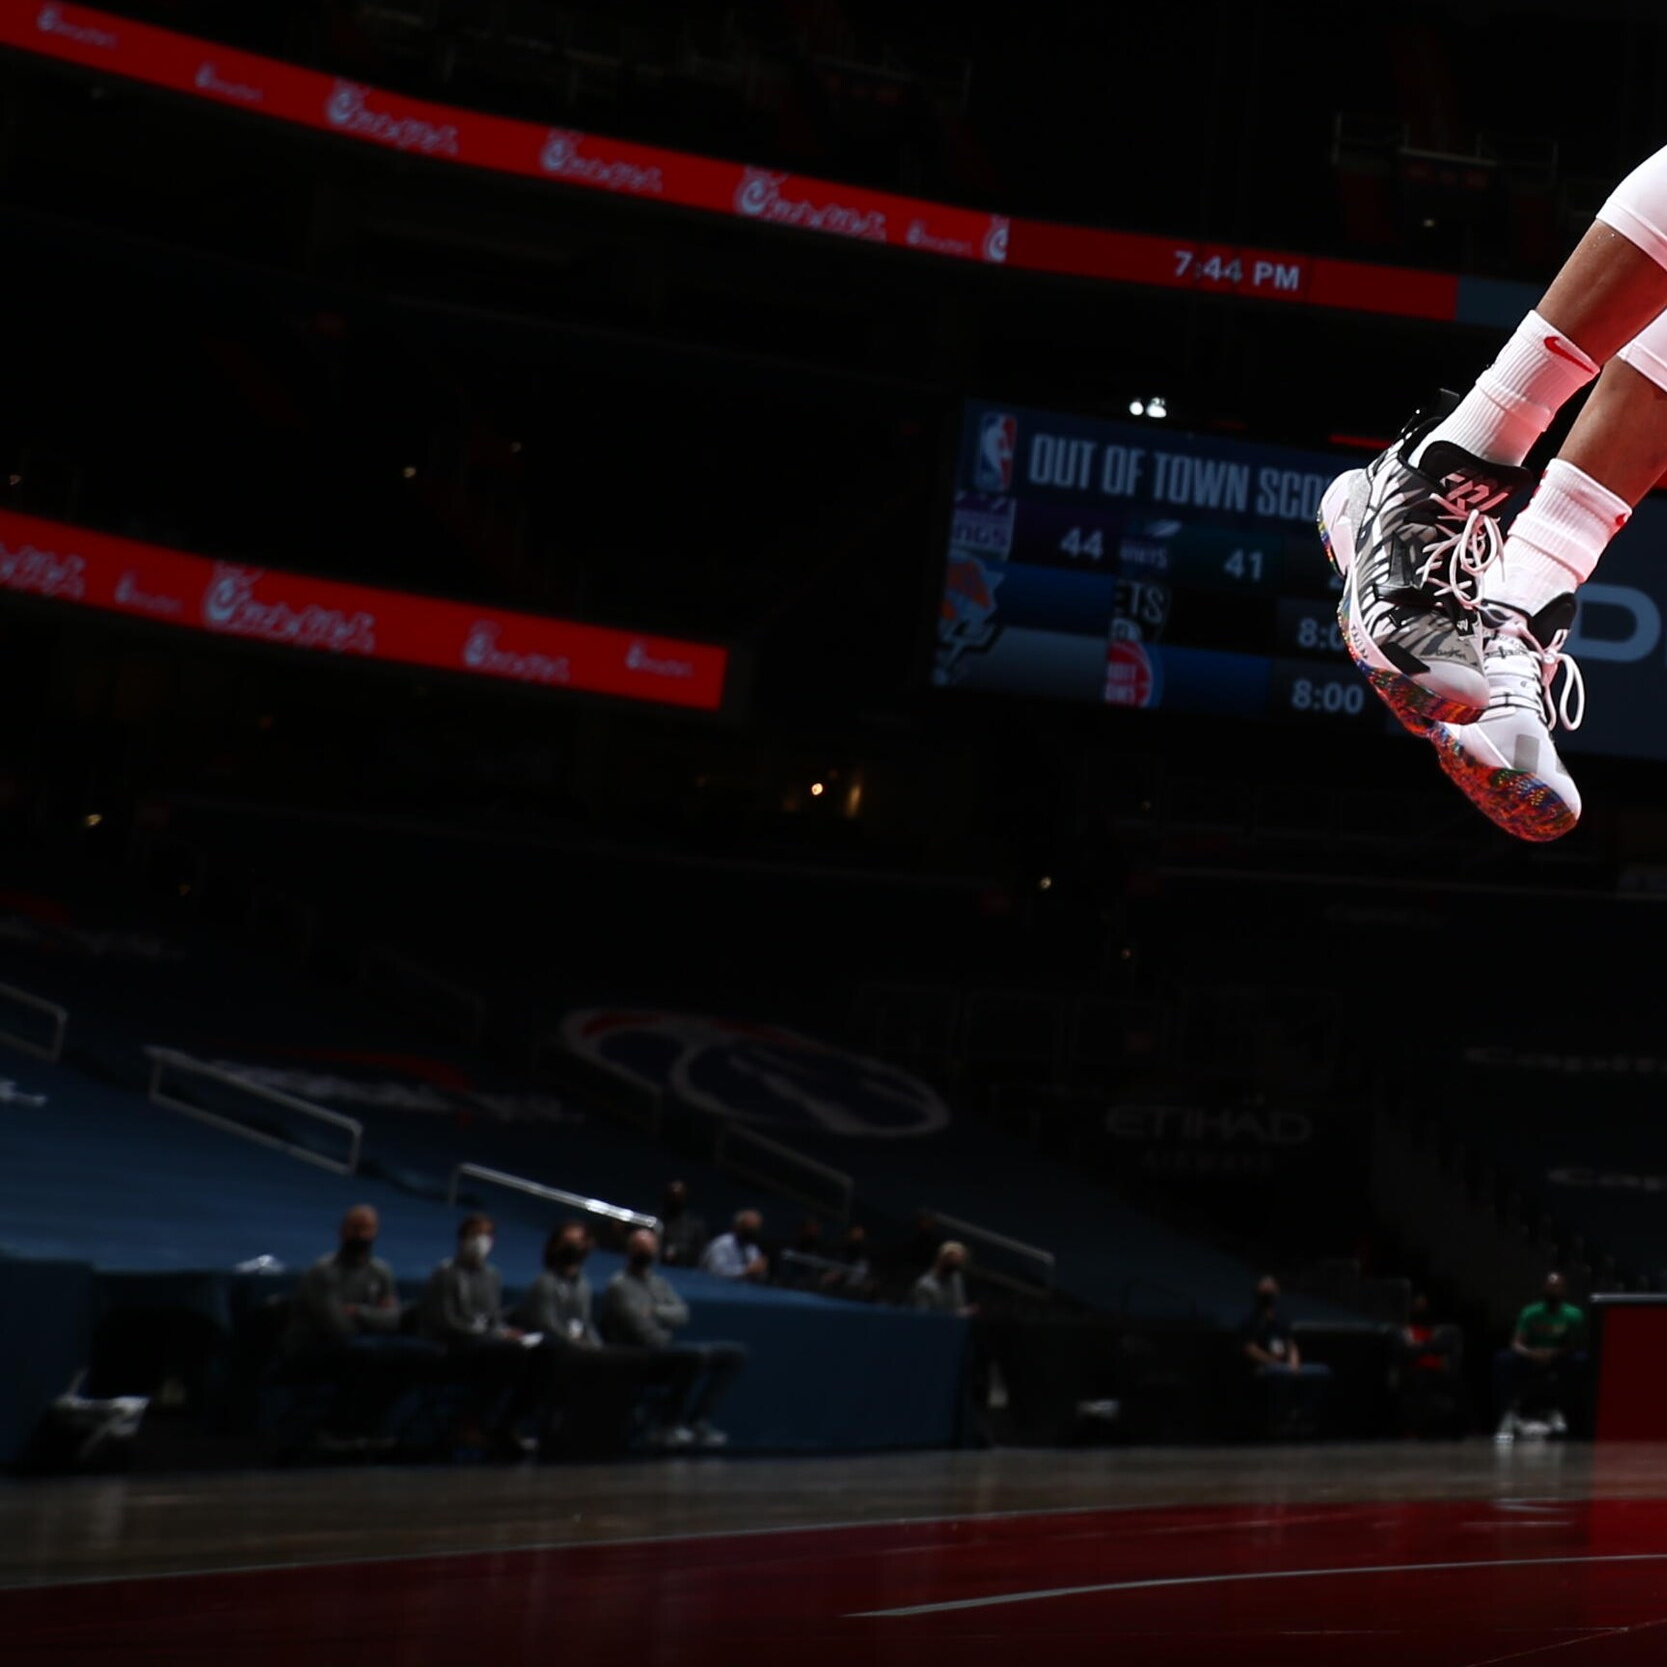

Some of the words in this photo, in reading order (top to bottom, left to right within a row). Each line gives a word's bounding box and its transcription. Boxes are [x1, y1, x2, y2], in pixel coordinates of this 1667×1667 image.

[1172, 249, 1244, 284] 7:44
[1252, 260, 1301, 292] PM
[1027, 433, 1098, 492] OUT
[1101, 443, 1148, 498] OF
[1152, 452, 1250, 513] TOWN
[1255, 466, 1330, 523] SCO
[1058, 526, 1105, 561] 44
[1223, 547, 1264, 583] 41
[1296, 617, 1344, 653] 8:0
[1290, 677, 1365, 716] 8:00
